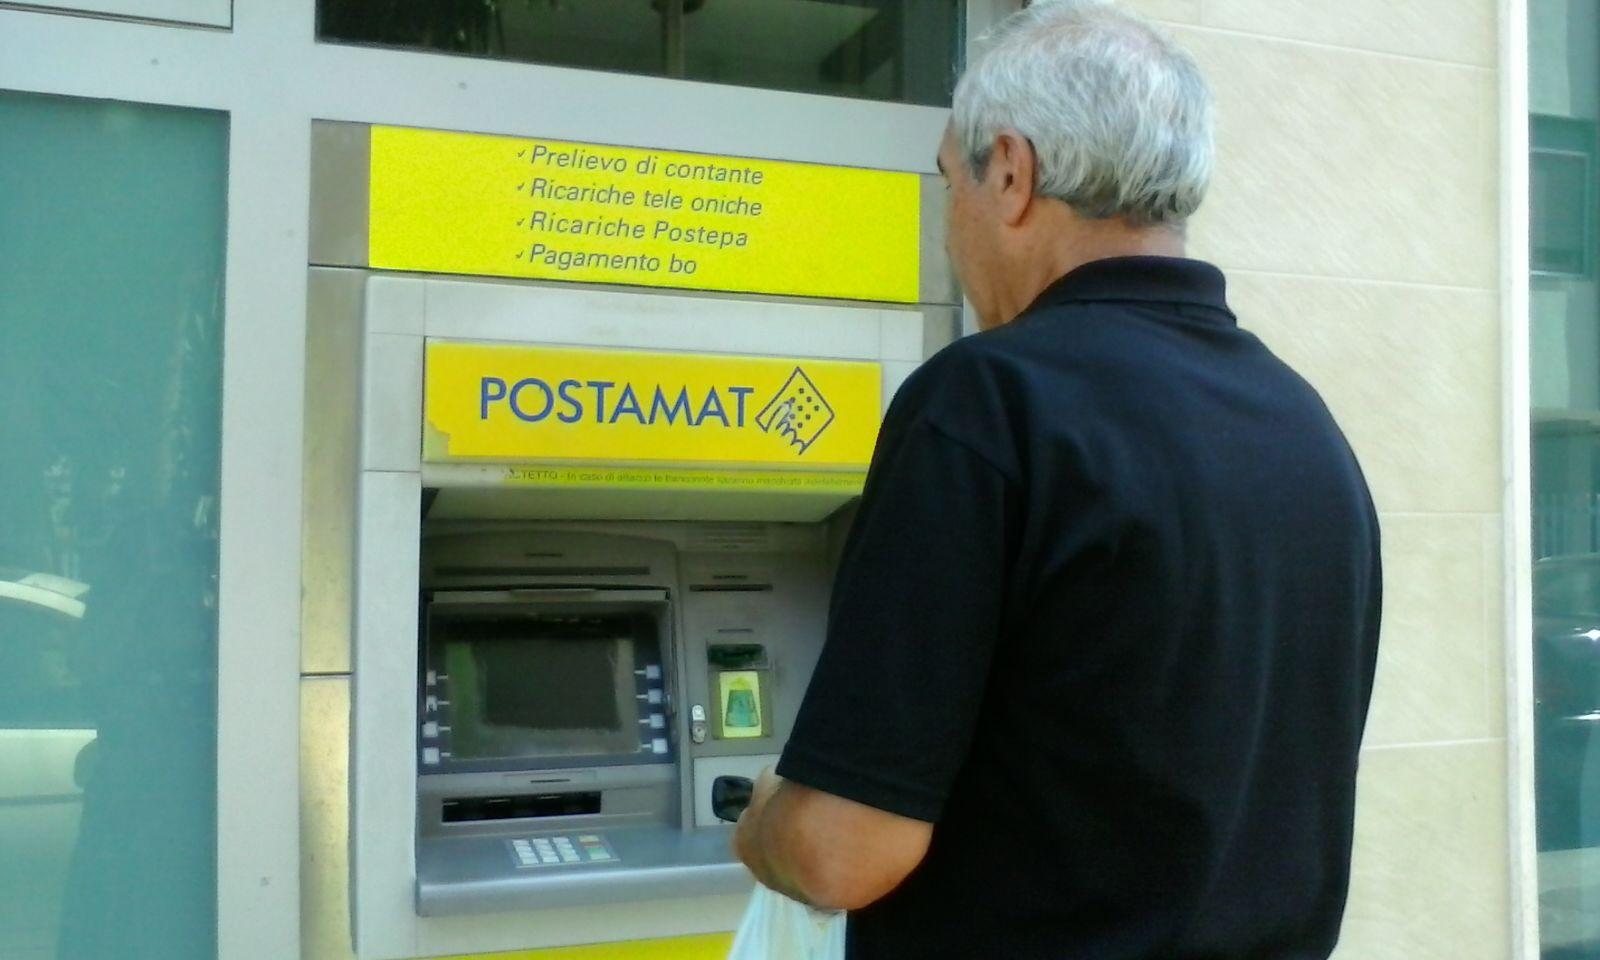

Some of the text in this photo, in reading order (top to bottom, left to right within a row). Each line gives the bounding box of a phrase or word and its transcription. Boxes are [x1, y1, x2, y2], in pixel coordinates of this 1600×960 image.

[531, 145, 764, 185] Prelievo di contante
[531, 178, 762, 216] Ricariche tele oniche
[530, 211, 748, 249] Ricariche Postepa
[530, 244, 697, 274] Pagamento bo
[481, 377, 754, 428] POSTAMAT
